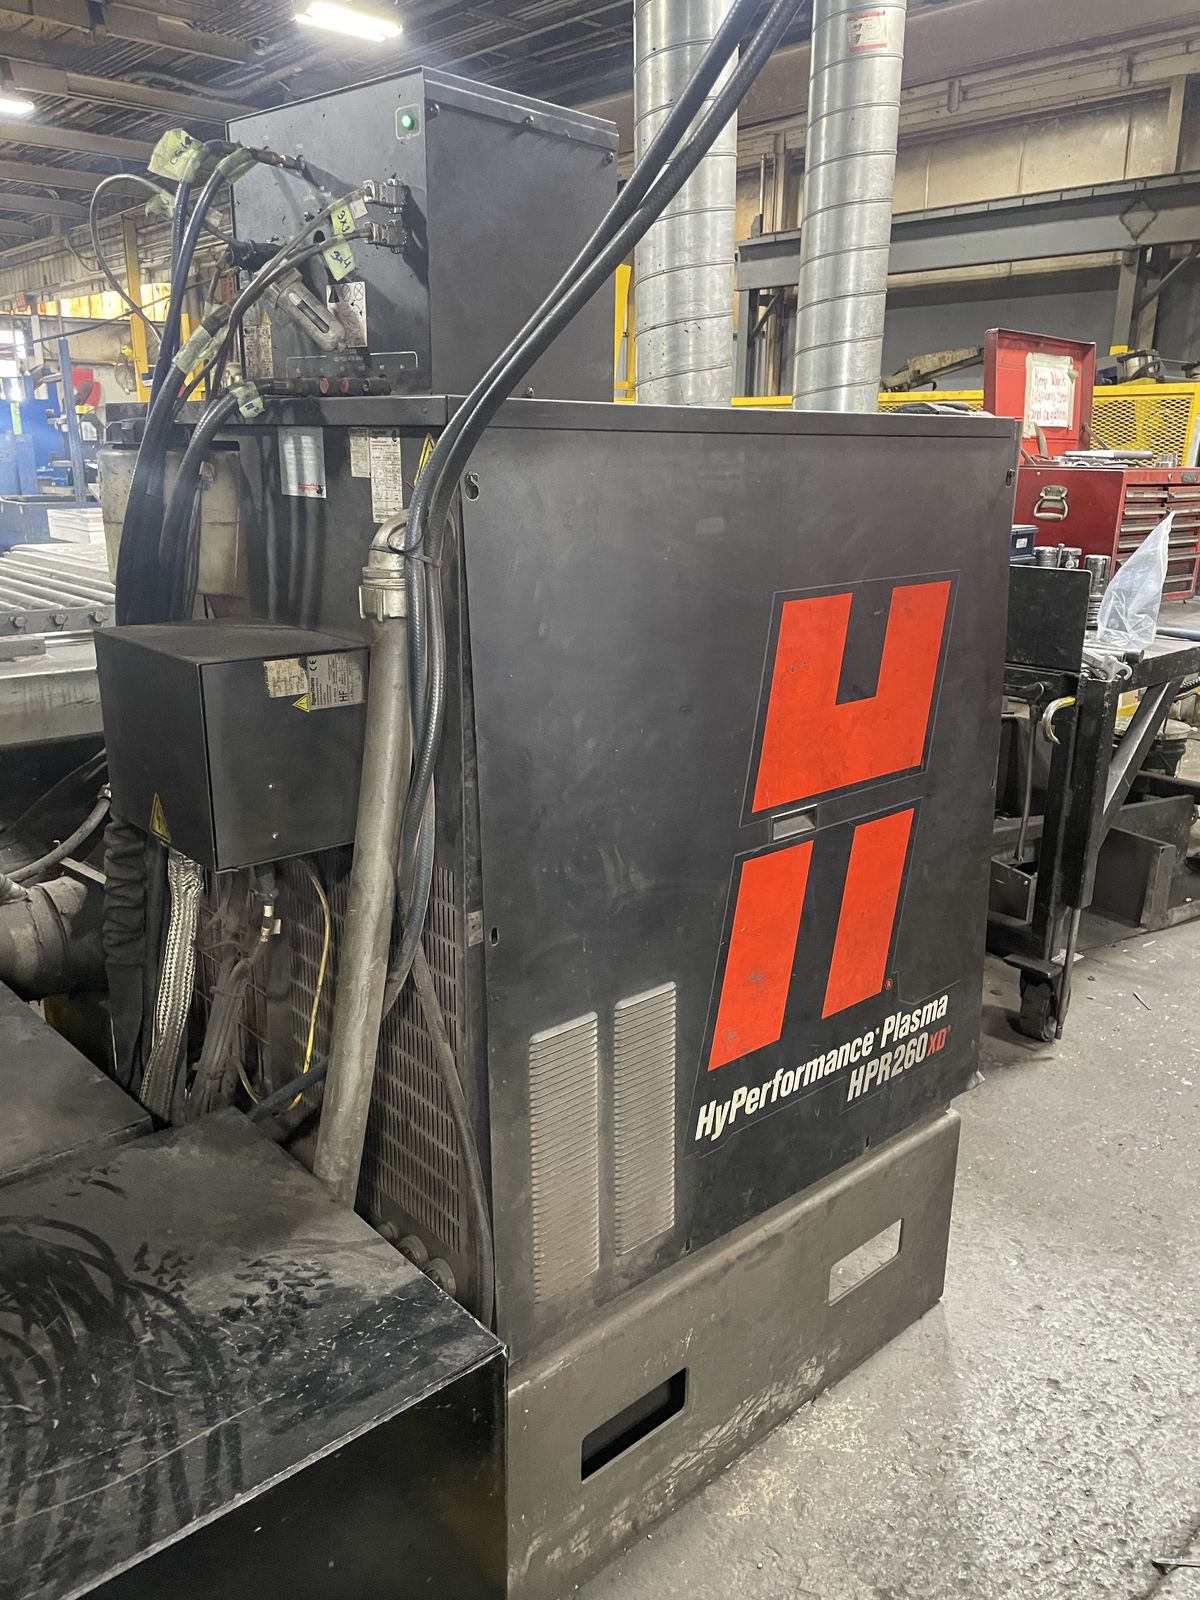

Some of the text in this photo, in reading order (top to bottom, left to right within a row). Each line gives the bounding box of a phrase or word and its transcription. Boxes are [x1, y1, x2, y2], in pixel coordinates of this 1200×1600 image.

[338, 690, 349, 702] HF
[694, 994, 949, 1142] HyPerformance Plasma
